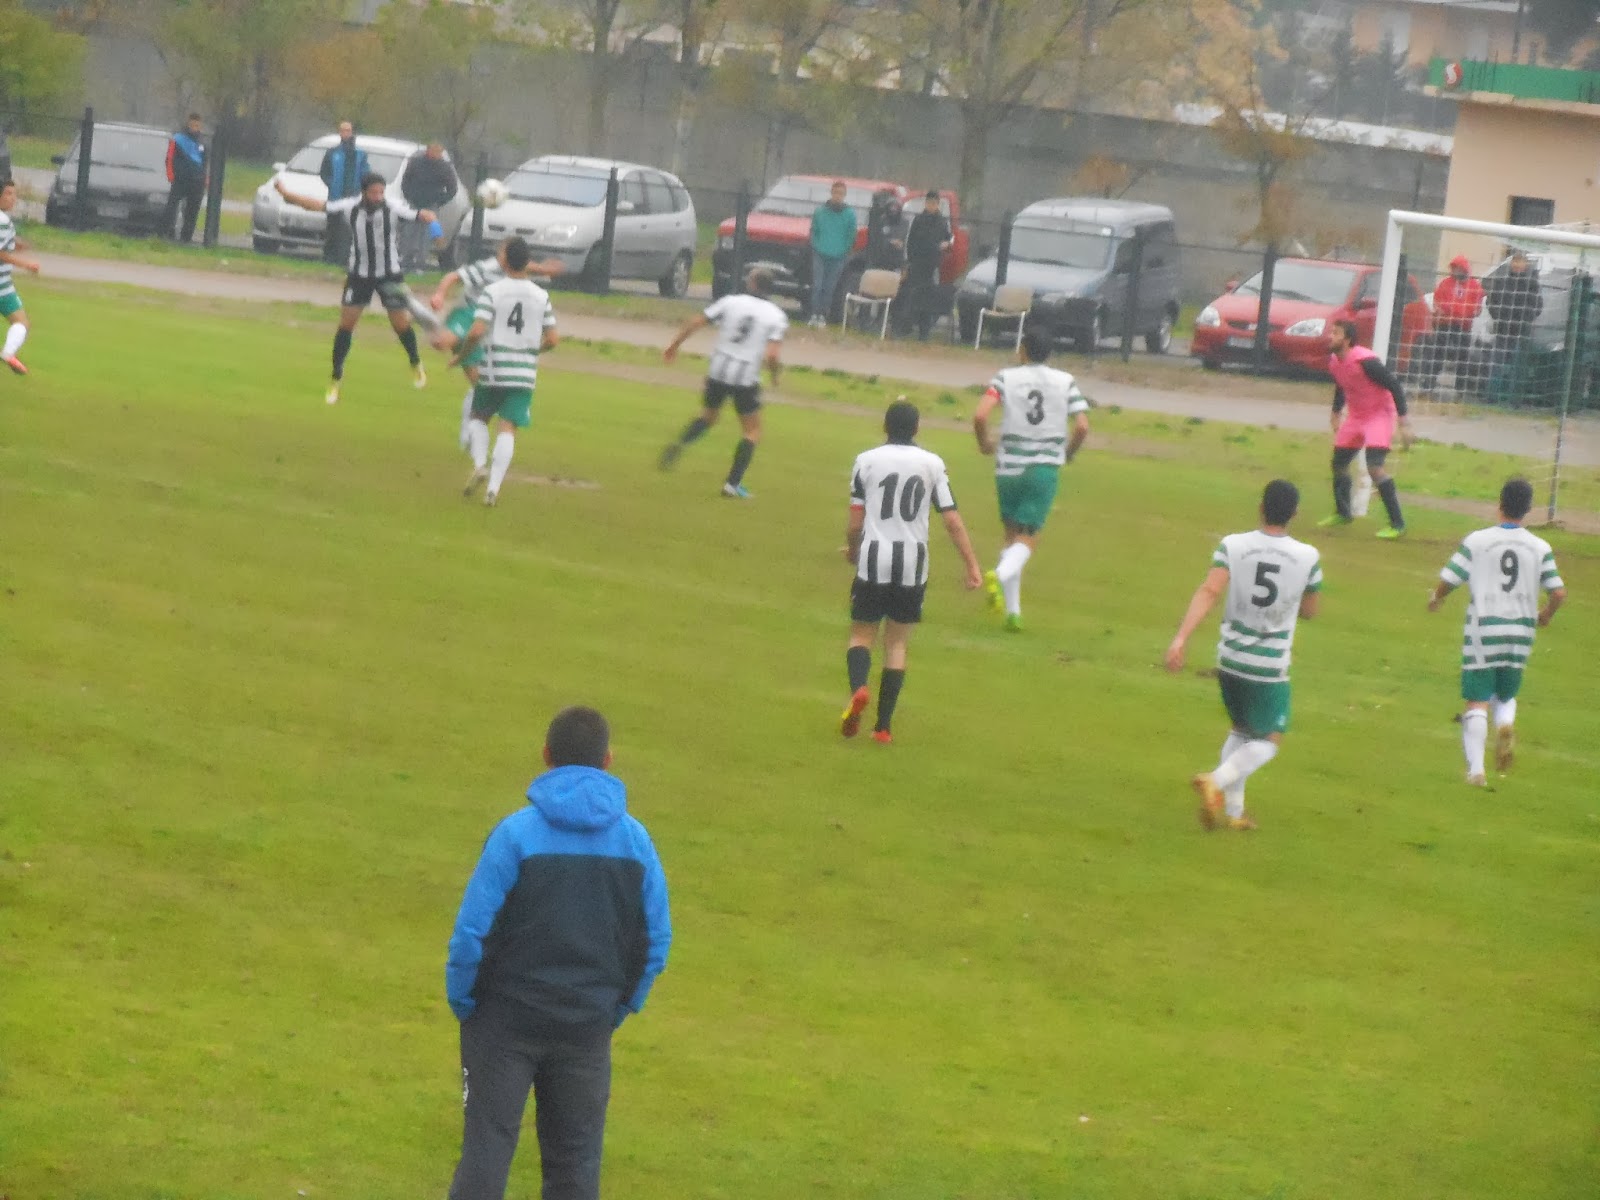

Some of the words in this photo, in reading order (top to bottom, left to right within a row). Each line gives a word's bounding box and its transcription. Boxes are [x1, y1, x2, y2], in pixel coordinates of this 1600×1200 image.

[507, 301, 525, 335] 4
[1026, 389, 1045, 425] 3
[878, 472, 926, 522] 10
[1251, 562, 1281, 608] 5
[1500, 549, 1519, 593] 9
